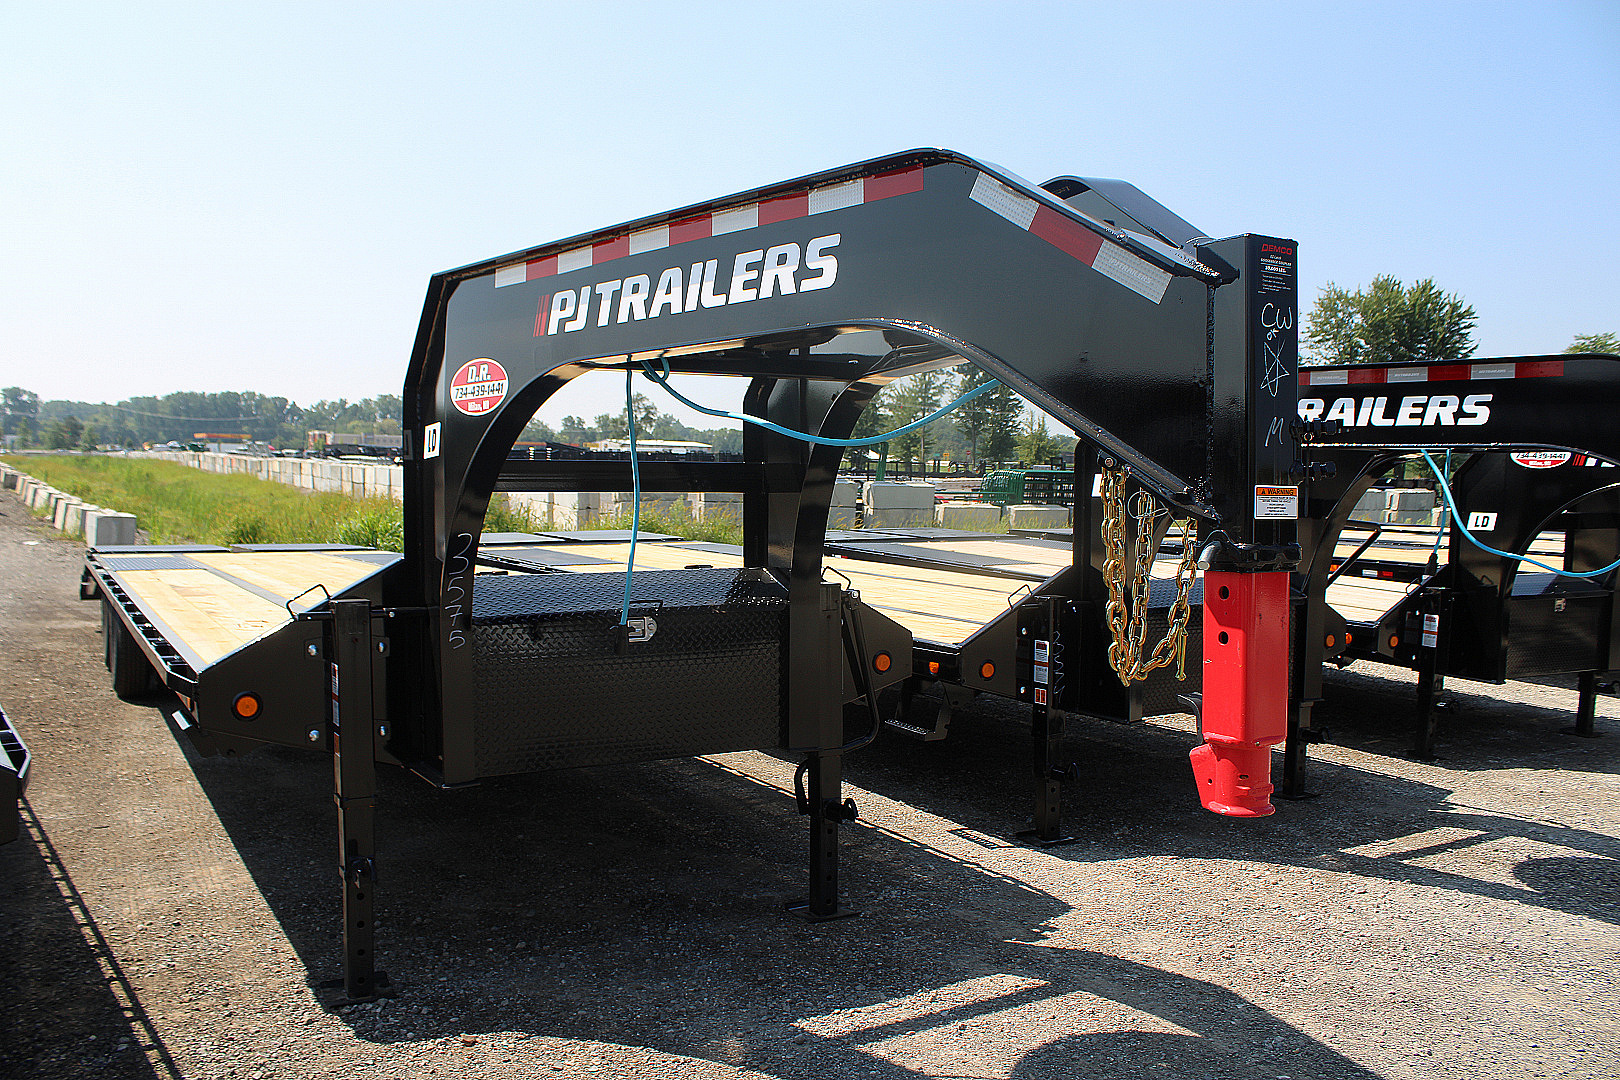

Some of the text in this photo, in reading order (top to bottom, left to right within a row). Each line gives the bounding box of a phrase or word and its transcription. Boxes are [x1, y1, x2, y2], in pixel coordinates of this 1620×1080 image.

[1261, 243, 1293, 256] DEMCO
[467, 363, 492, 383] D.R.
[454, 382, 505, 400] 734-439-1441
[1473, 515, 1490, 528] LD
